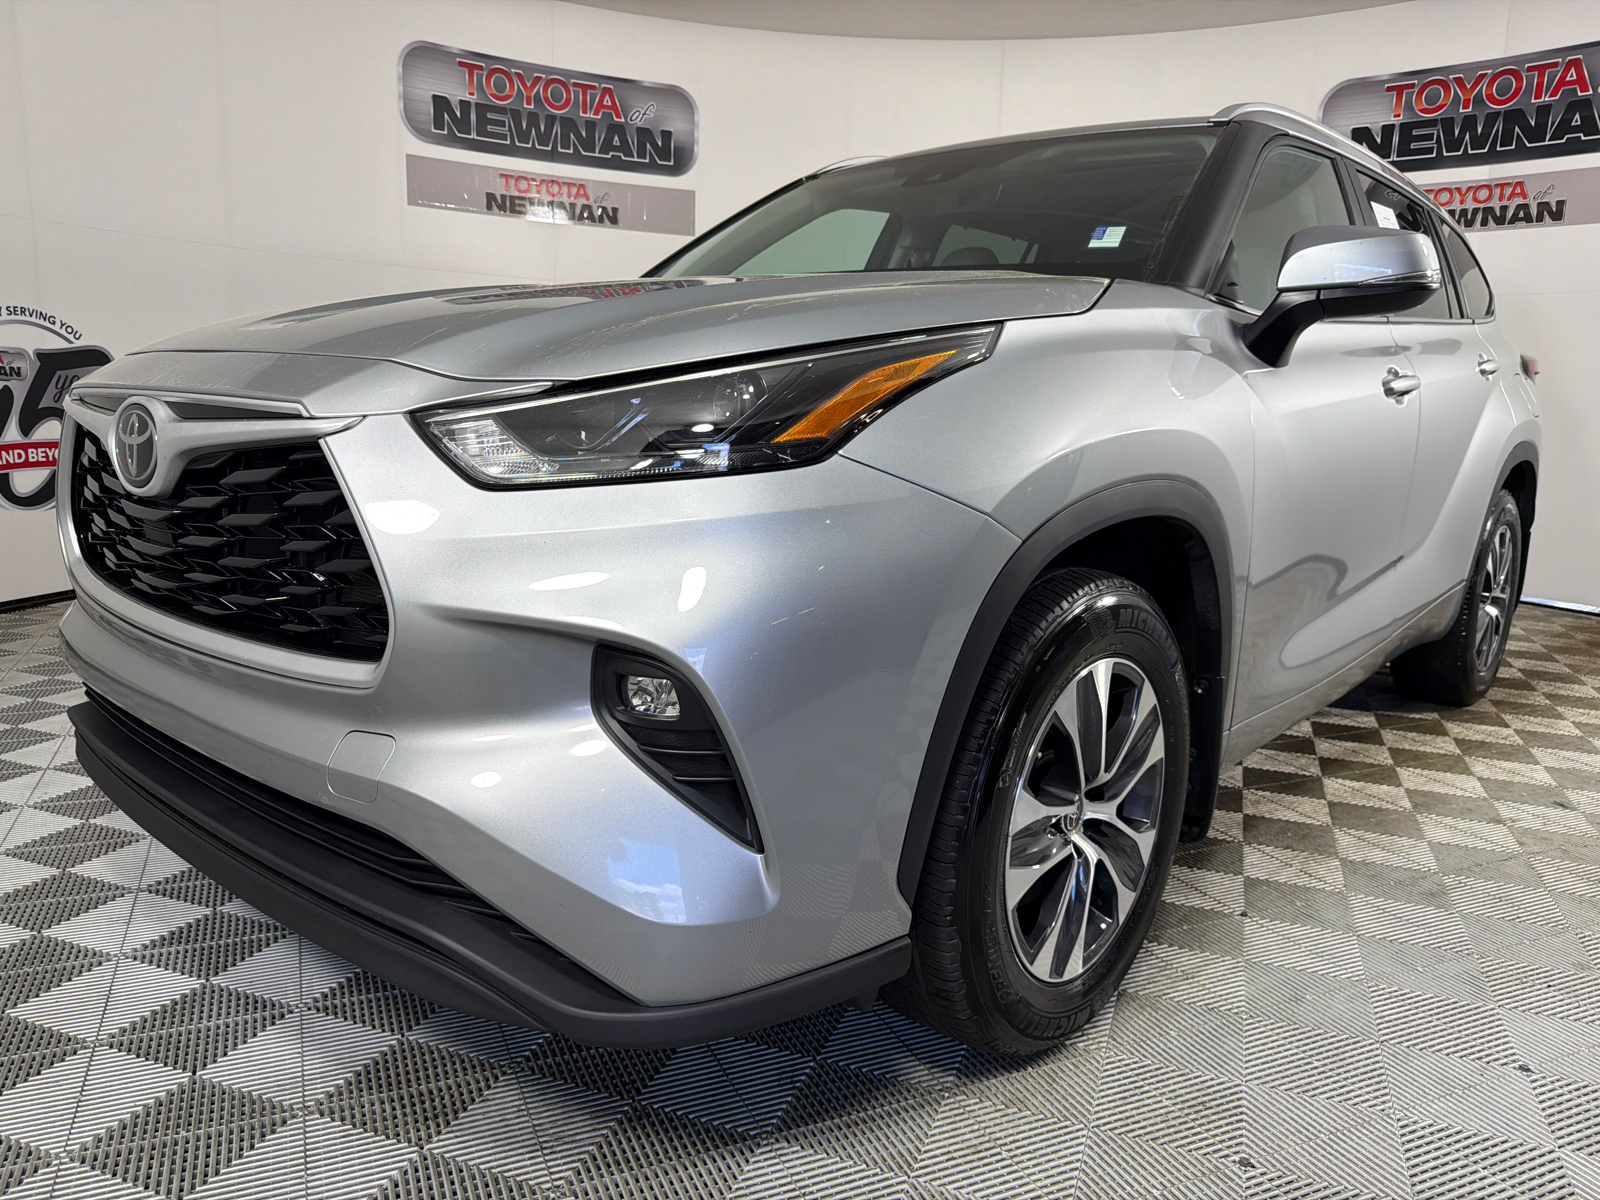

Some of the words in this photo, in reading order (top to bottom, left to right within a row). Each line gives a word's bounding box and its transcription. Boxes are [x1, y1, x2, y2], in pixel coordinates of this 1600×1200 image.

[456, 58, 624, 122] TOYOTA
[628, 102, 656, 124] of
[1385, 55, 1592, 120] TOYOTA
[431, 93, 674, 165] NEWNAN
[1351, 97, 1600, 161] NEWNA
[499, 172, 591, 201] TOYOTA
[1533, 184, 1556, 200] of
[1448, 199, 1567, 229] WNAN
[5, 305, 57, 326] SERVING
[59, 319, 83, 341] YOU
[0, 449, 26, 465] ND
[27, 447, 58, 462] BEY
